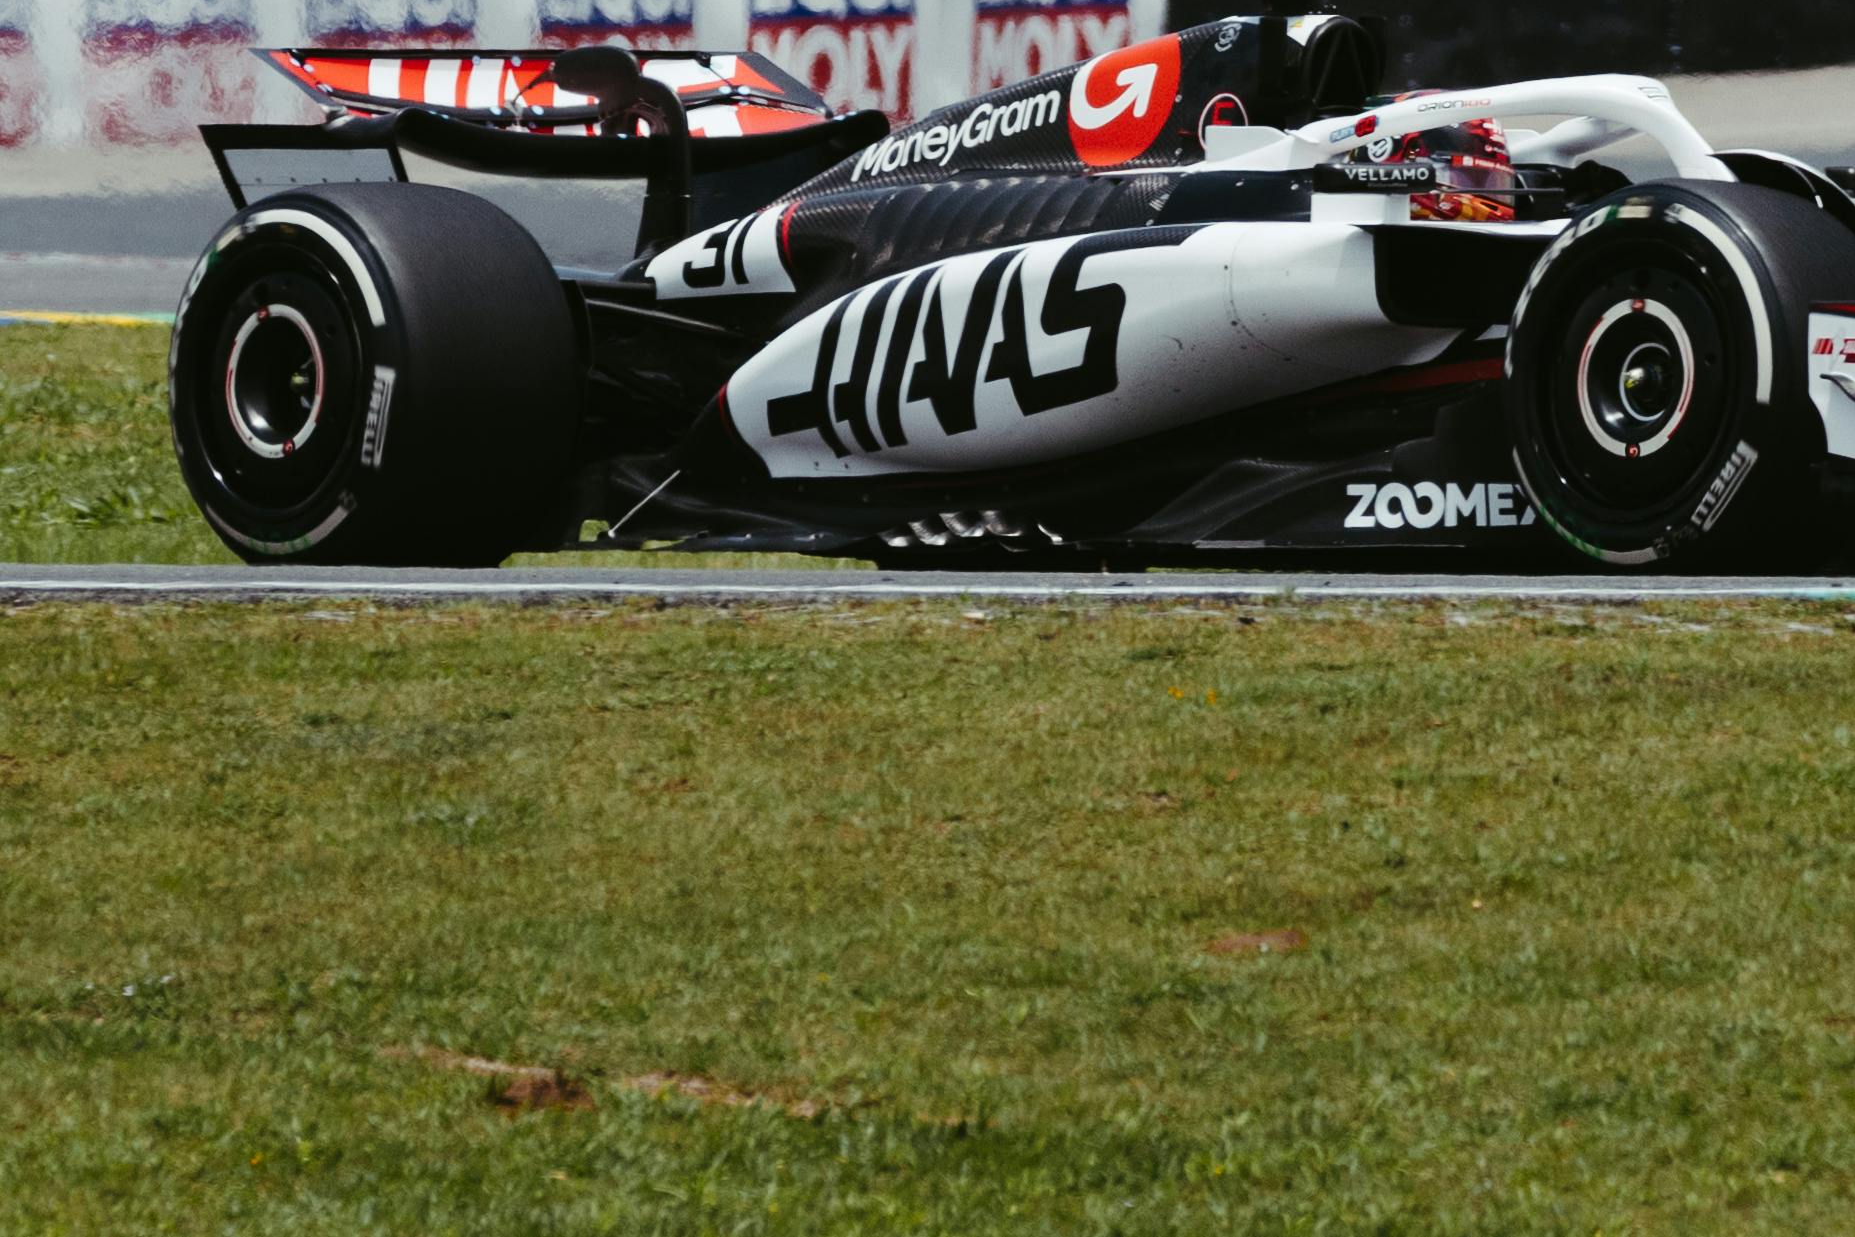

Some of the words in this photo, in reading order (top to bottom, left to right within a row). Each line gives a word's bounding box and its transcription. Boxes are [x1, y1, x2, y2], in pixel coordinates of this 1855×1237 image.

[851, 90, 1061, 182] MoneyGram
[1344, 167, 1430, 182] VELLAMO
[767, 225, 1204, 458] HAAS
[361, 365, 396, 469] PIRELLI
[1690, 439, 1759, 532] PIRELLI
